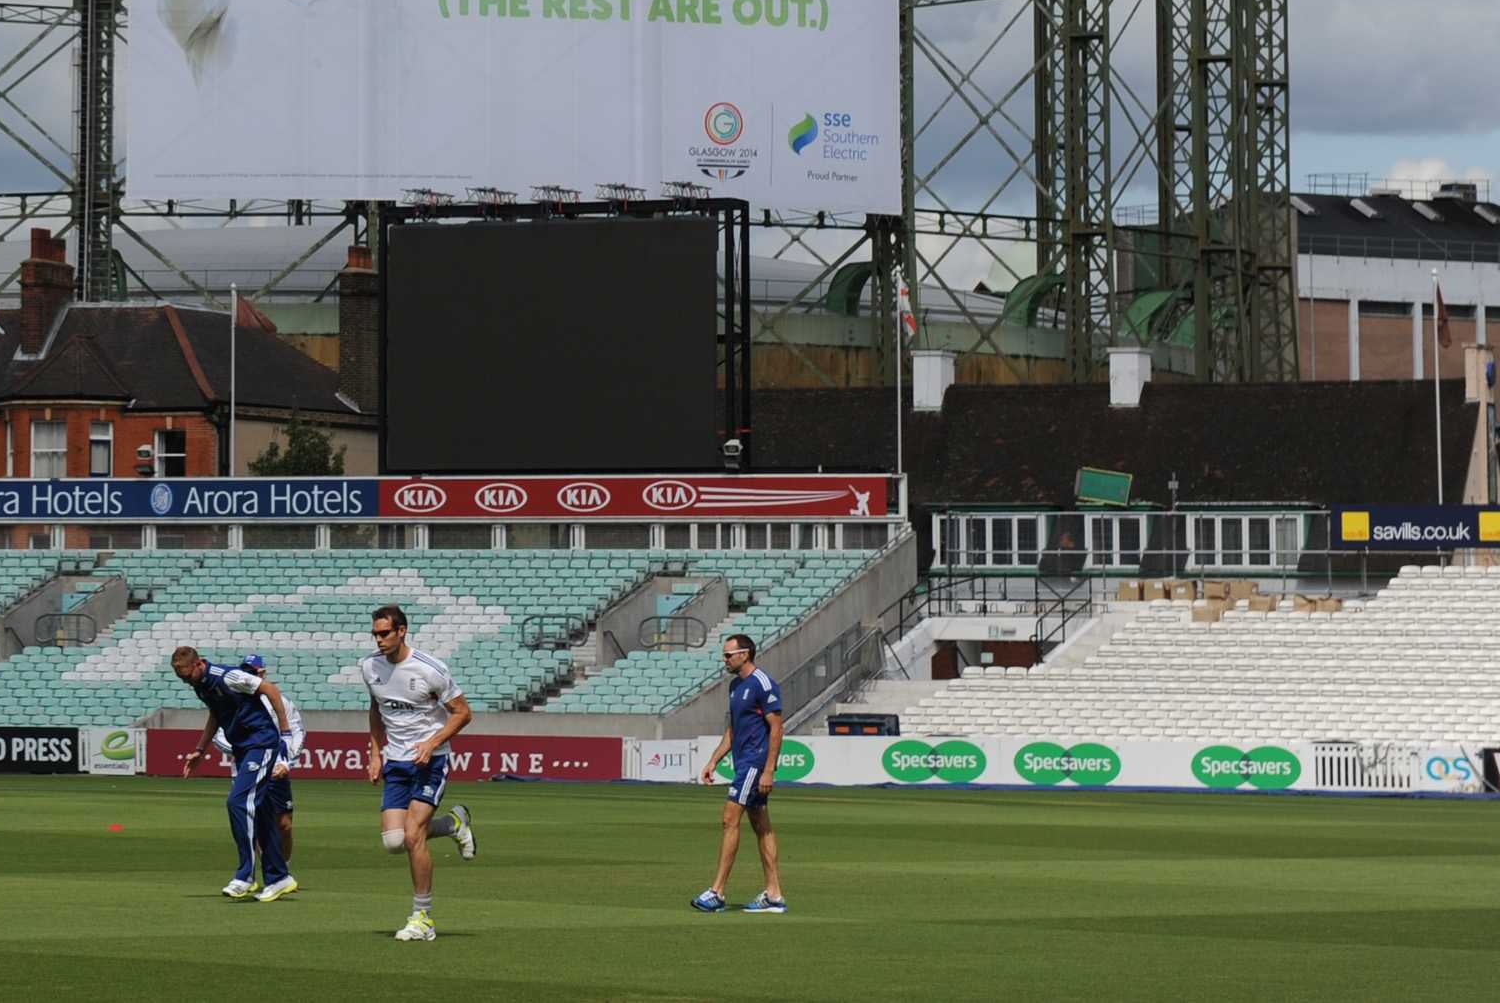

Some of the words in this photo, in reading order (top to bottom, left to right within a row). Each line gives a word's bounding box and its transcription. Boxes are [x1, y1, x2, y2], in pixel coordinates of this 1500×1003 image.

[823, 112, 851, 127] sse
[823, 129, 879, 146] Southern
[688, 147, 737, 158] GLASGOW
[739, 149, 758, 158] 2014
[823, 145, 868, 161] Electric
[807, 170, 830, 182] Proud
[832, 171, 859, 183] Partner
[32, 482, 123, 515] Hotels
[183, 486, 259, 514] Arora
[270, 482, 363, 514] Hotels
[403, 489, 439, 506] KIA
[484, 489, 520, 506] KIA
[566, 489, 602, 505] KIA
[652, 486, 688, 503] KIA
[1373, 522, 1471, 541] savills.co.uk
[11, 737, 73, 762] PRESS
[661, 752, 686, 769] JLT
[891, 750, 977, 769] Specsavers
[1023, 752, 1111, 772] Specsavers
[1201, 756, 1291, 777] Specsavers
